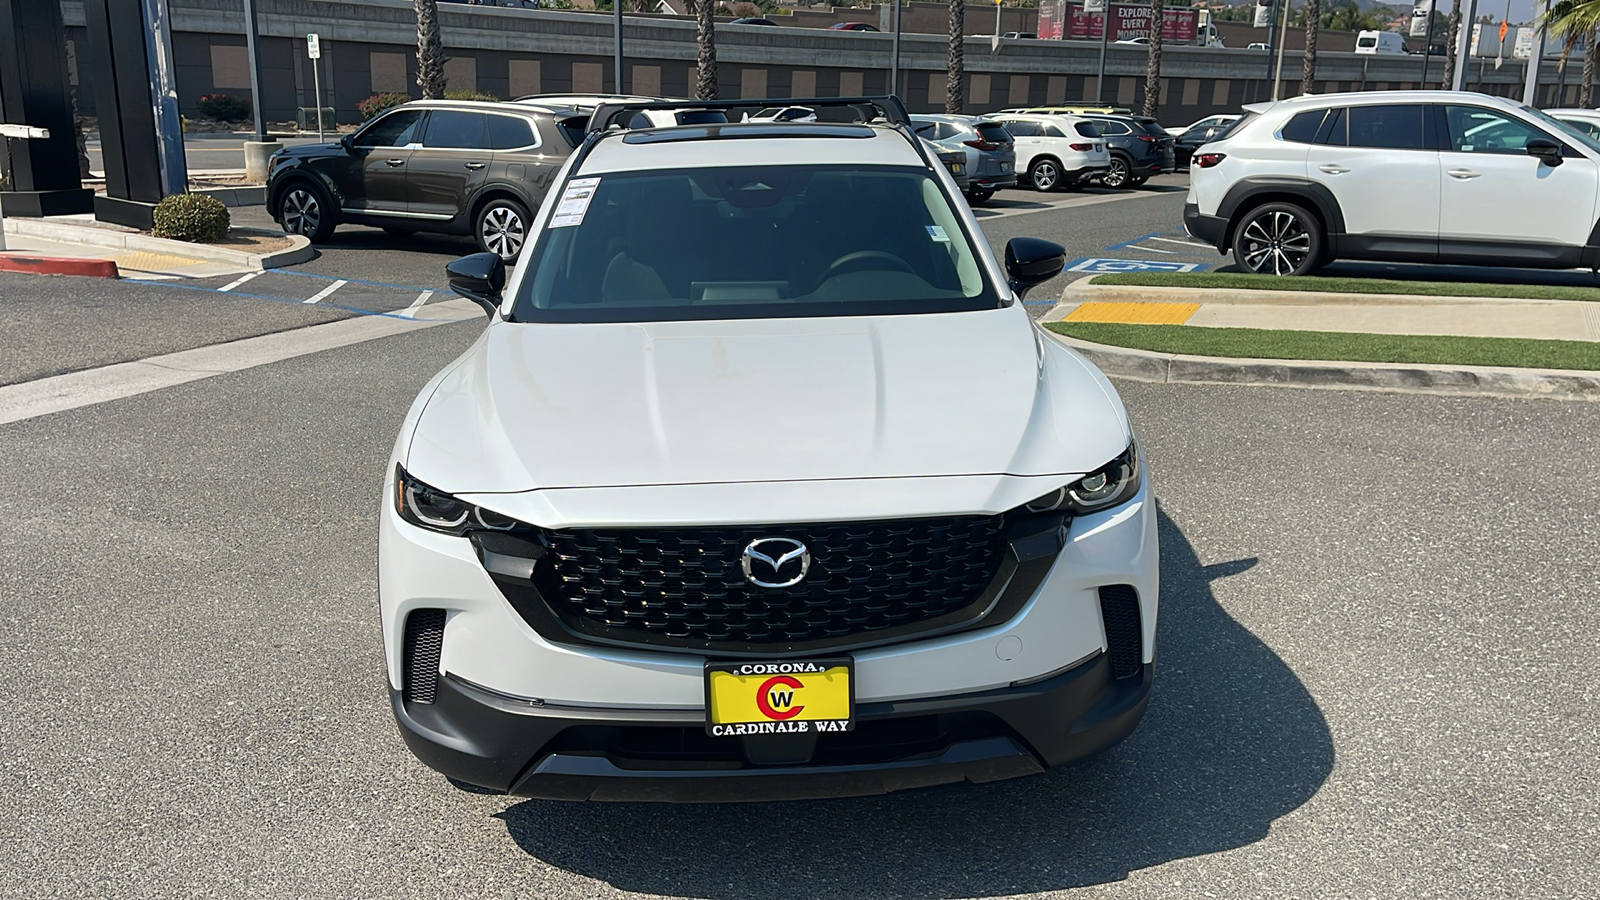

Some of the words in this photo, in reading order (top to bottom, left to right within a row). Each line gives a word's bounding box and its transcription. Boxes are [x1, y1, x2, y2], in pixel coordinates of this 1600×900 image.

[1118, 7, 1152, 18] EXPLORE
[1122, 18, 1147, 29] EVERY
[740, 662, 818, 675] CORONA
[712, 721, 809, 736] CARDINALE
[814, 720, 850, 732] WAY
